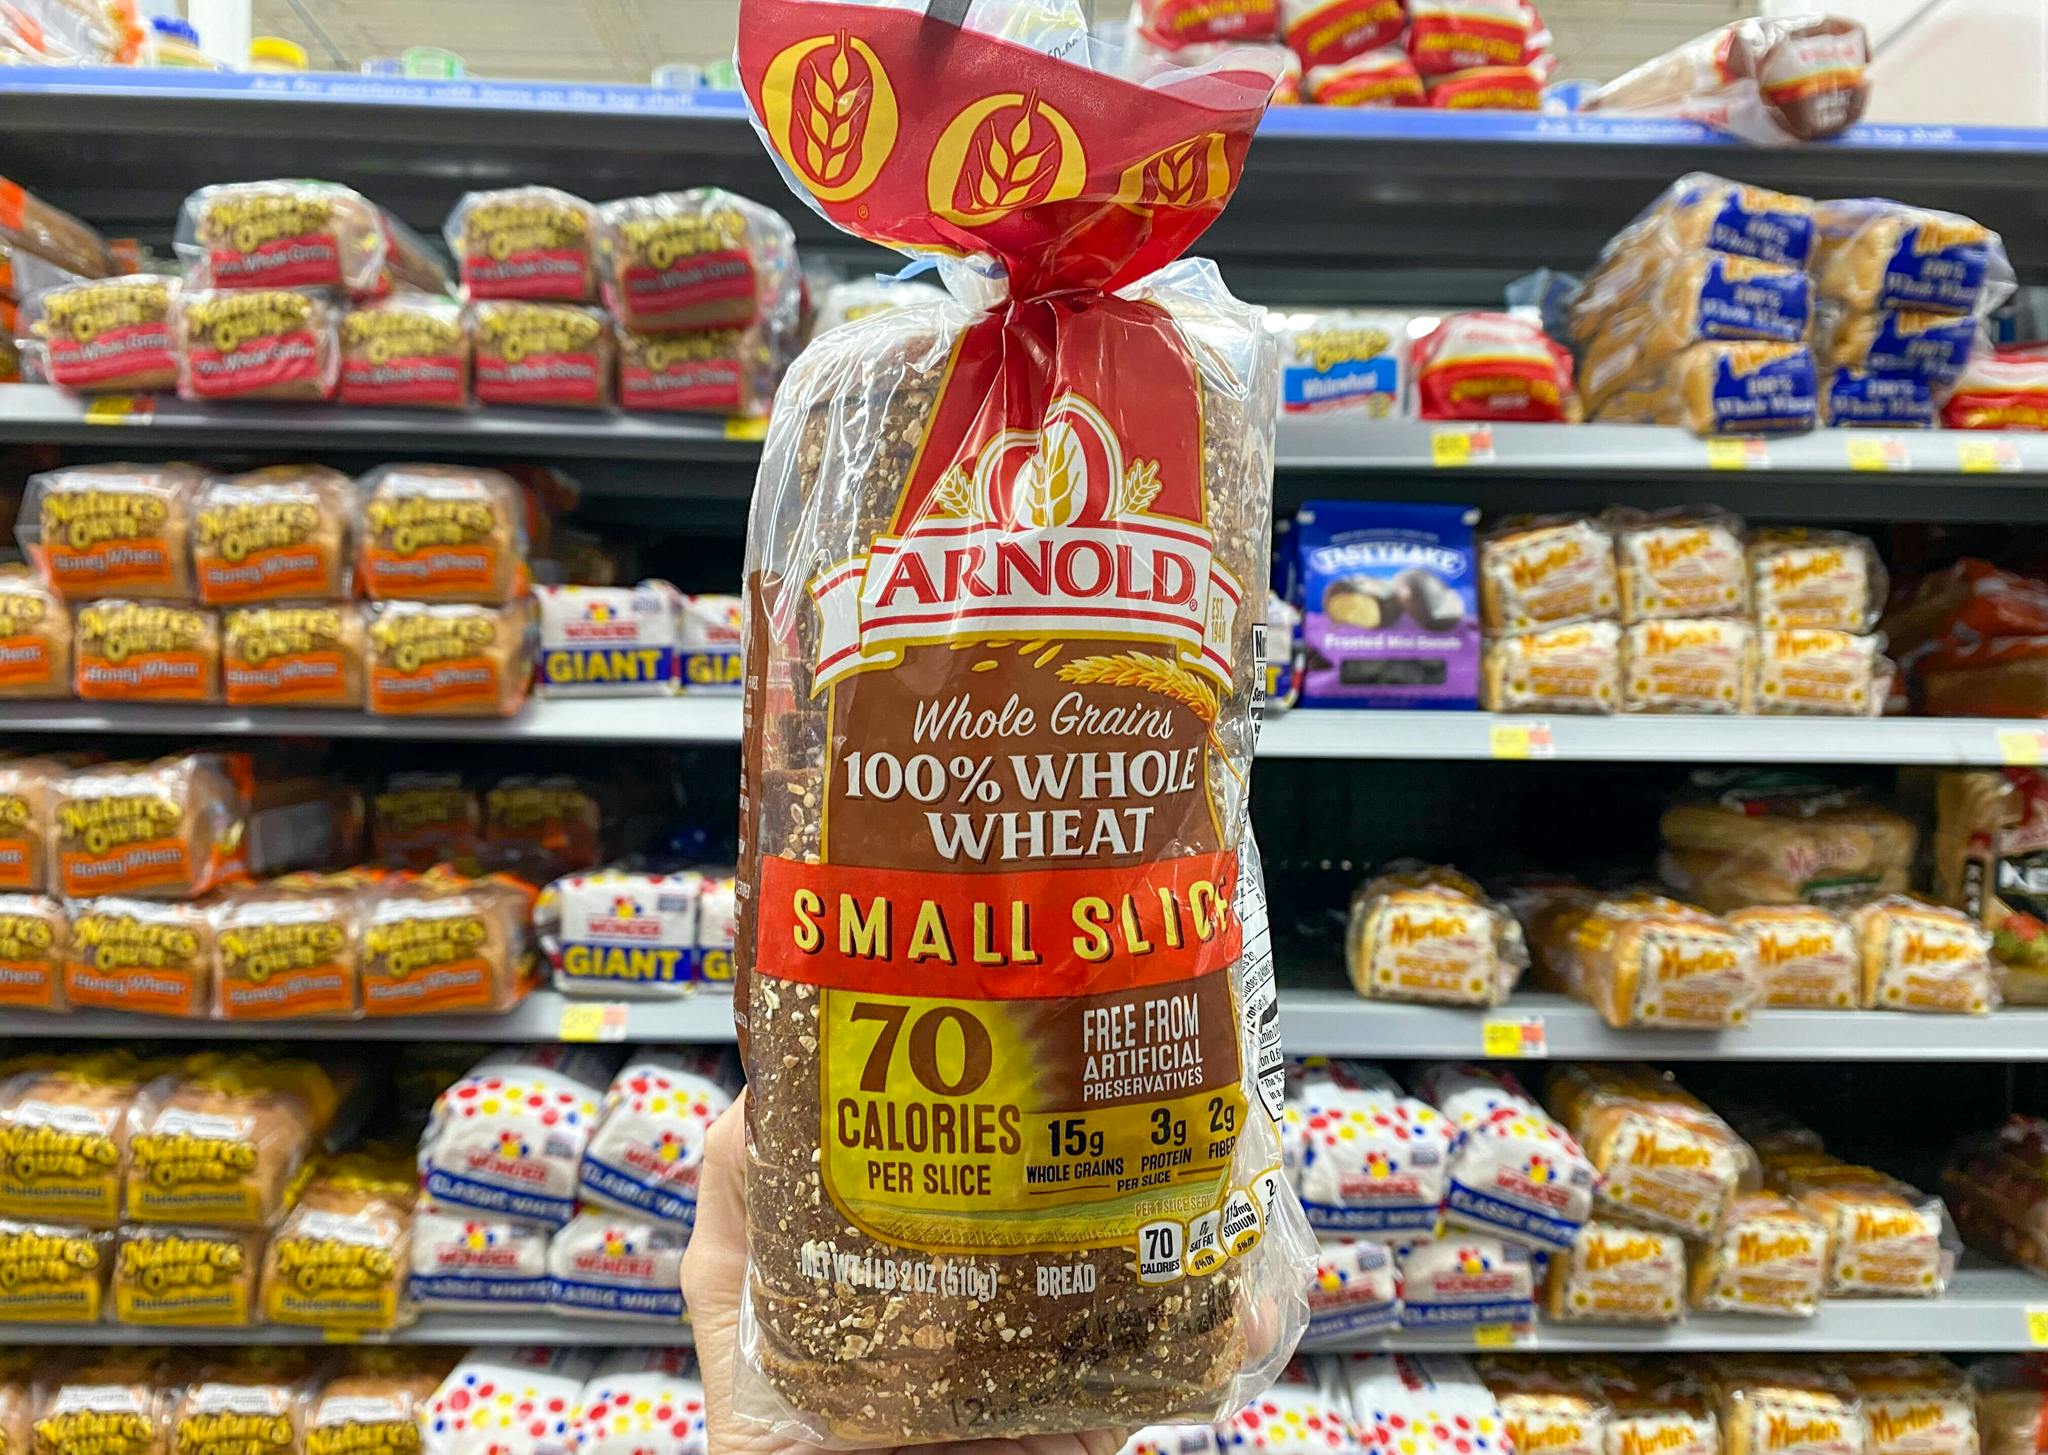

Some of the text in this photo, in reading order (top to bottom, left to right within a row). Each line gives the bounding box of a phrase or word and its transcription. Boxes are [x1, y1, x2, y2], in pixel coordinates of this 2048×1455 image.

[876, 539, 1197, 608] ARNOLD
[1211, 620, 1226, 643] 1940
[545, 650, 662, 684] GIANT
[686, 652, 742, 685] GIA
[913, 690, 1175, 745] Whole Grains
[844, 747, 1198, 804] 100% WHOLE
[925, 806, 1155, 861] WHEAT
[793, 887, 1041, 967] SMALL
[563, 948, 681, 980] GIANT
[1083, 993, 1200, 1054] FREE FROM
[850, 1001, 993, 1096] 70
[1083, 1043, 1204, 1083] ARTIFICIAL
[1083, 1066, 1204, 1102] PRESERVATIVES
[838, 1097, 1022, 1155] CALORIES
[1150, 1107, 1187, 1147] 3g
[1208, 1096, 1235, 1133] 2g
[1047, 1118, 1105, 1159] 15g
[1026, 1157, 1124, 1185] WHOLE GRAINS
[1141, 1146, 1192, 1172] PROTEIN
[867, 1160, 992, 1197] PER SLICE
[1117, 1170, 1171, 1193] PER SLICE
[1145, 1228, 1174, 1260] 70
[1190, 1233, 1214, 1252] SAT FAT
[1223, 1213, 1258, 1238] SODIUM
[801, 1246, 998, 1302] NET WT 1 LB 2 OZ (510g)
[1036, 1263, 1096, 1297] BREAD
[1140, 1259, 1180, 1275] CALORIES
